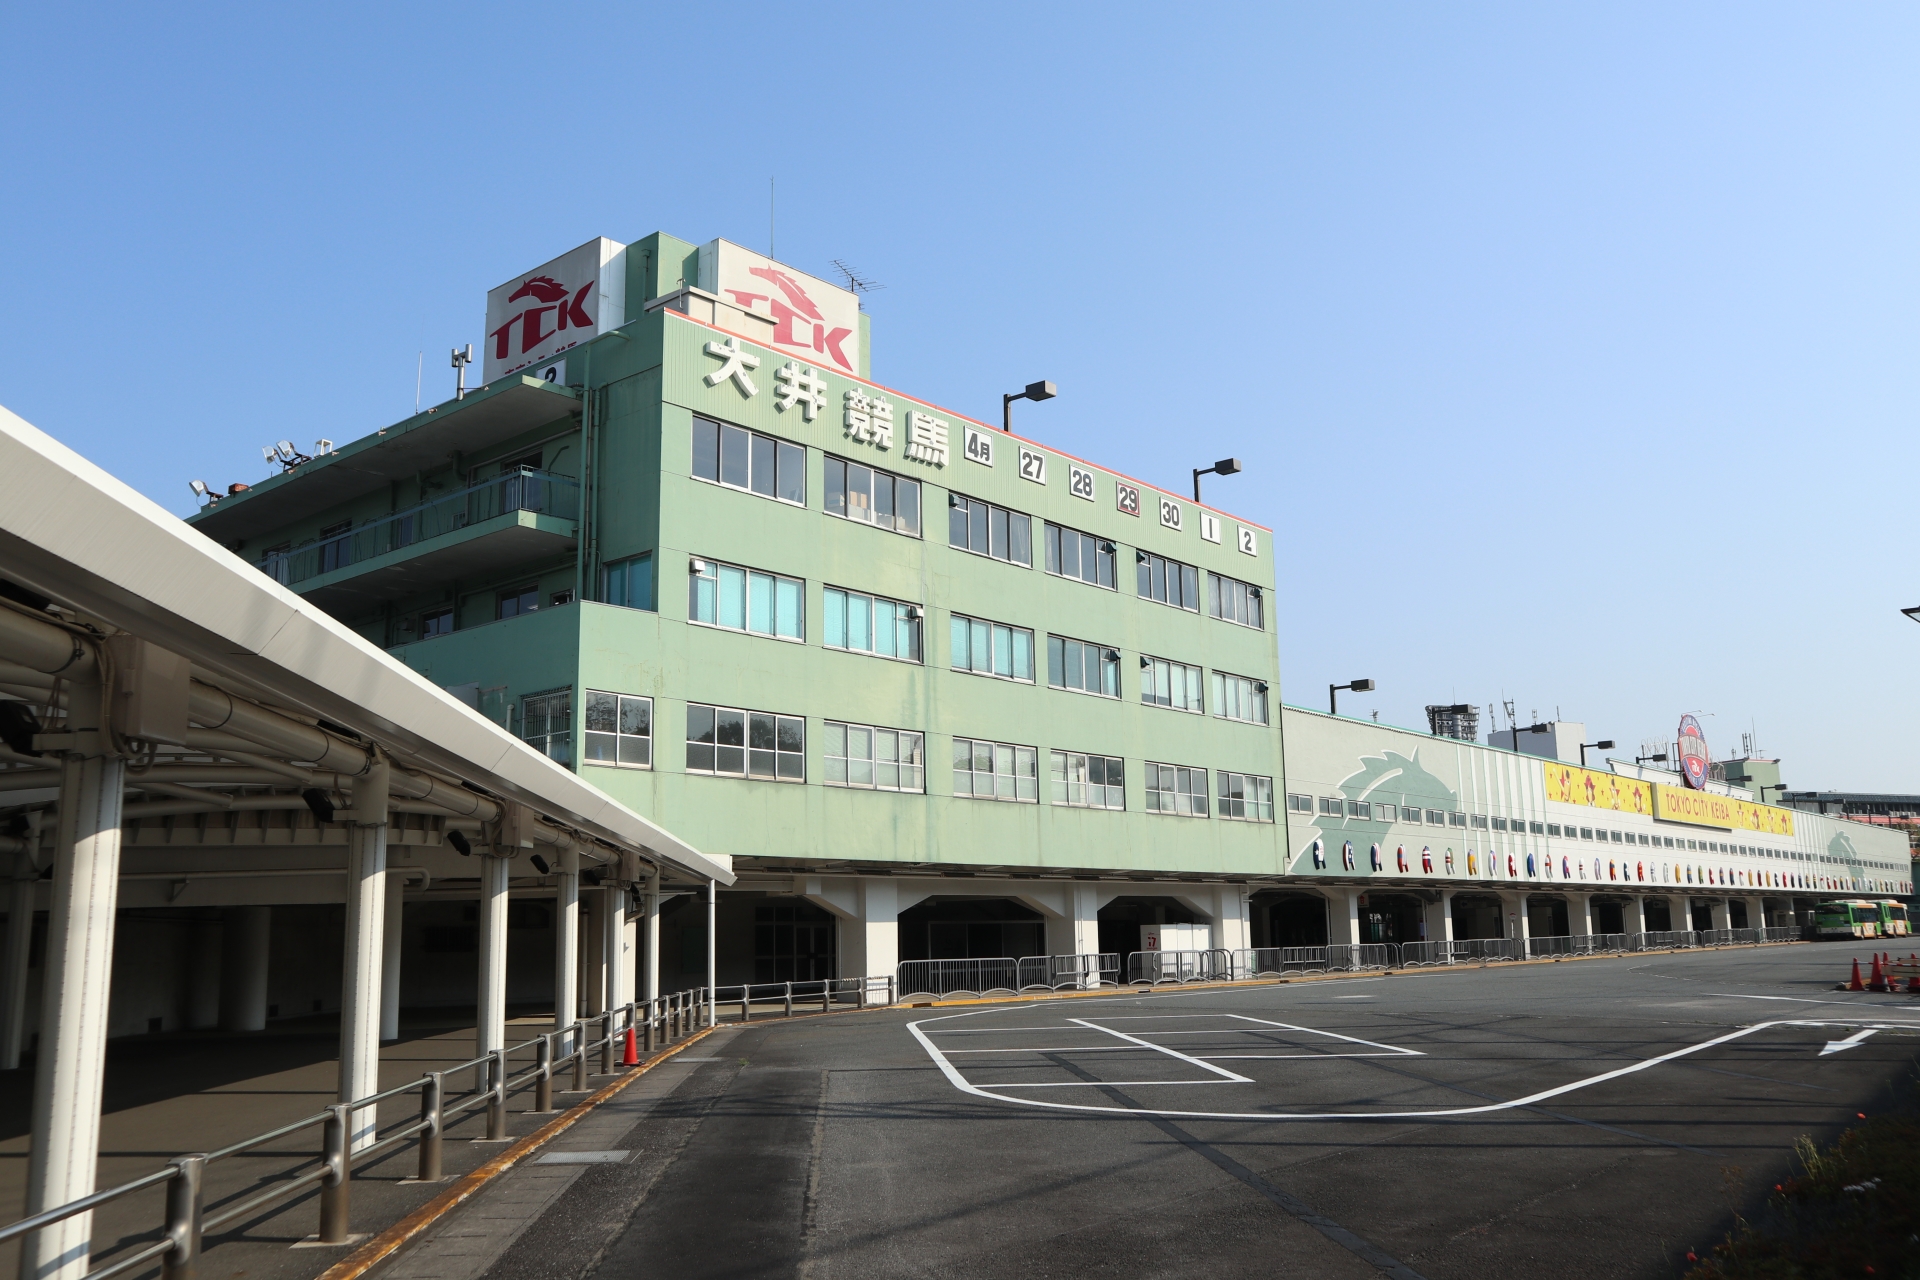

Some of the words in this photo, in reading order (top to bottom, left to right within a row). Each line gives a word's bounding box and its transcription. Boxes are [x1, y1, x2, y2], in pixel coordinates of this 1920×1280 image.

[490, 279, 595, 360] TCK
[704, 337, 949, 467] 大井競馬
[968, 433, 990, 461] 4月
[1022, 452, 1044, 480] 27
[1072, 469, 1093, 497] 28
[1119, 486, 1138, 512] 29
[1162, 502, 1180, 527] 30
[1207, 517, 1213, 539] 1
[1243, 531, 1252, 551] 2
[1666, 793, 1692, 815] TOKYO
[1693, 798, 1708, 817] CITY
[1711, 801, 1730, 820] KEIBA
